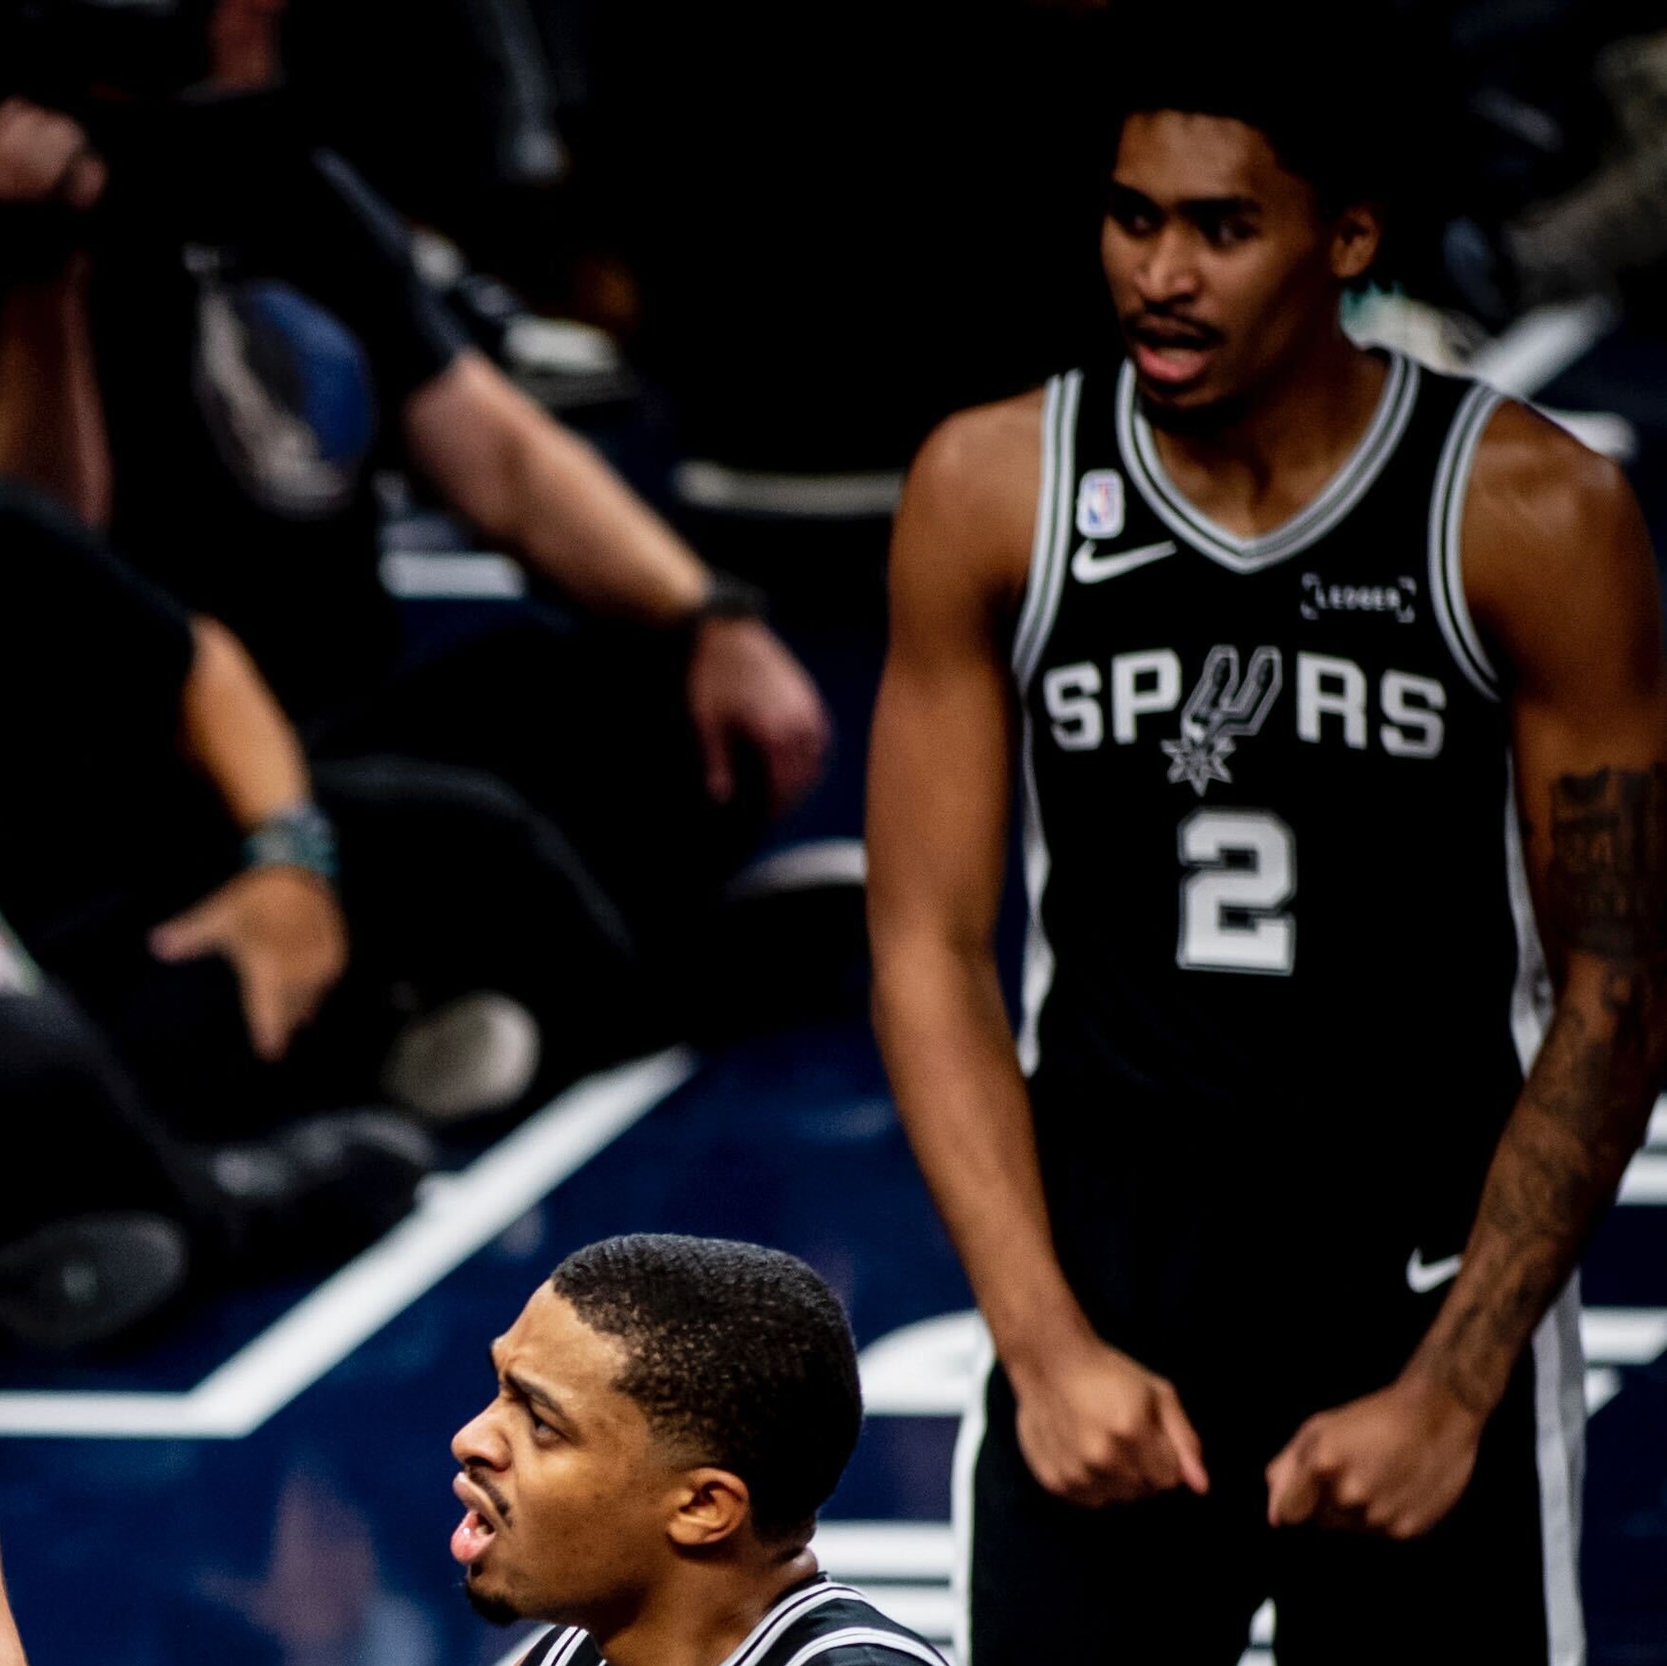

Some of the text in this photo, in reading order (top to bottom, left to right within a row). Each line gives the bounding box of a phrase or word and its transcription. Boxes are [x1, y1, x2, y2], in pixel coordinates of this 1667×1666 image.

[1313, 583, 1401, 612] LEDGER
[1041, 643, 1447, 798] SPURS
[1175, 806, 1297, 976] 2
